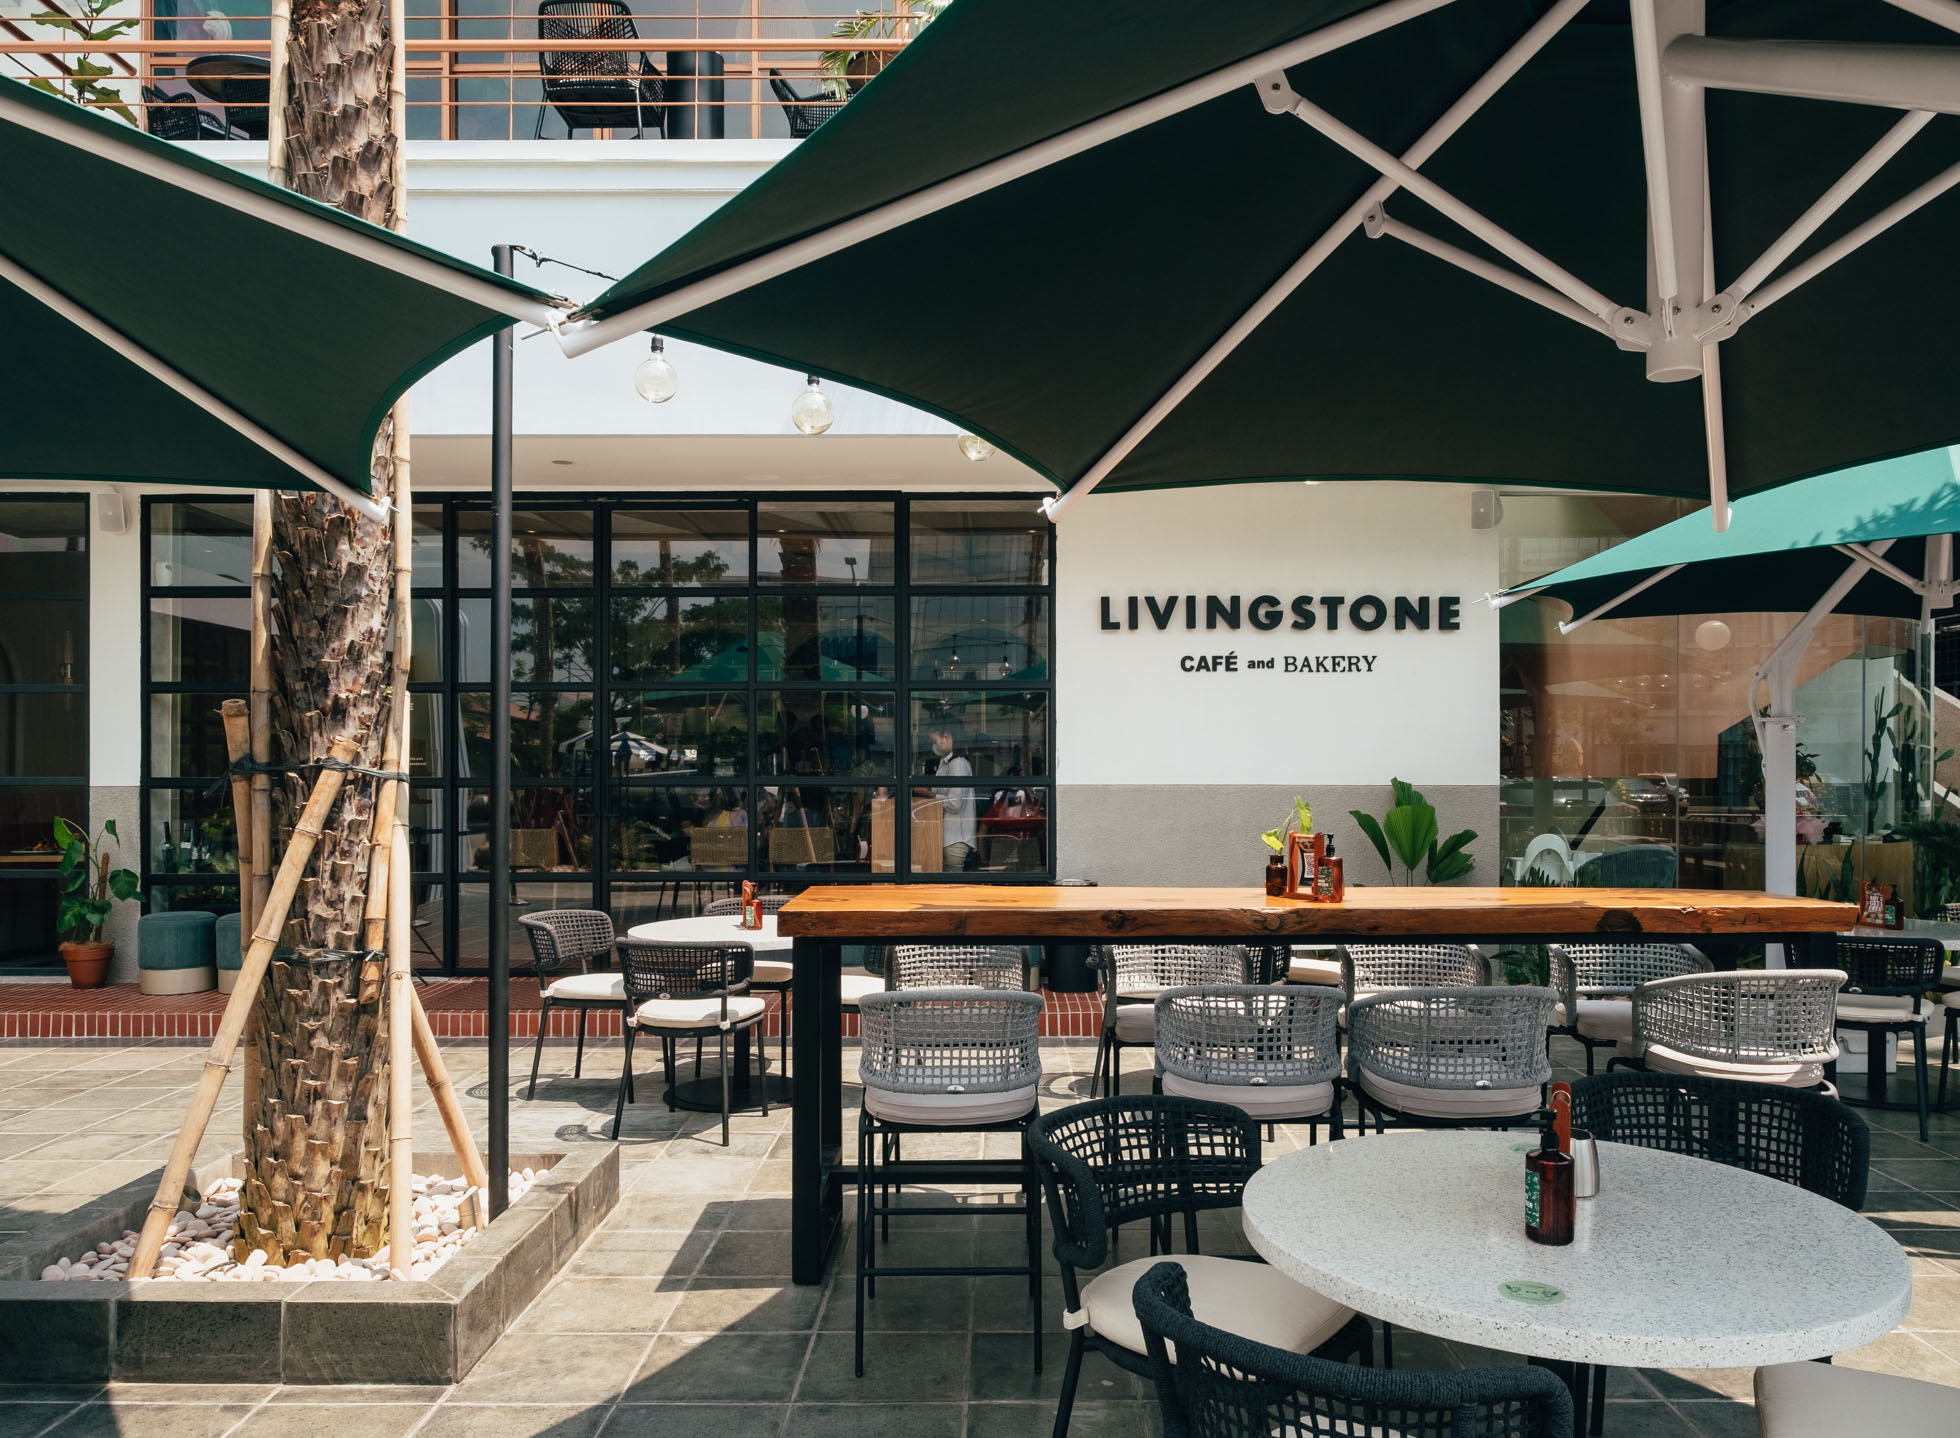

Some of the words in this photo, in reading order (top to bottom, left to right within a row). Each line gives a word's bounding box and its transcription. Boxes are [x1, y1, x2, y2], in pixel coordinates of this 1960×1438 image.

[1100, 594, 1461, 631] LIVINGSTONE
[1180, 651, 1238, 672] CAFÉ
[1247, 657, 1275, 669] and
[1284, 656, 1377, 672] BAKERY
